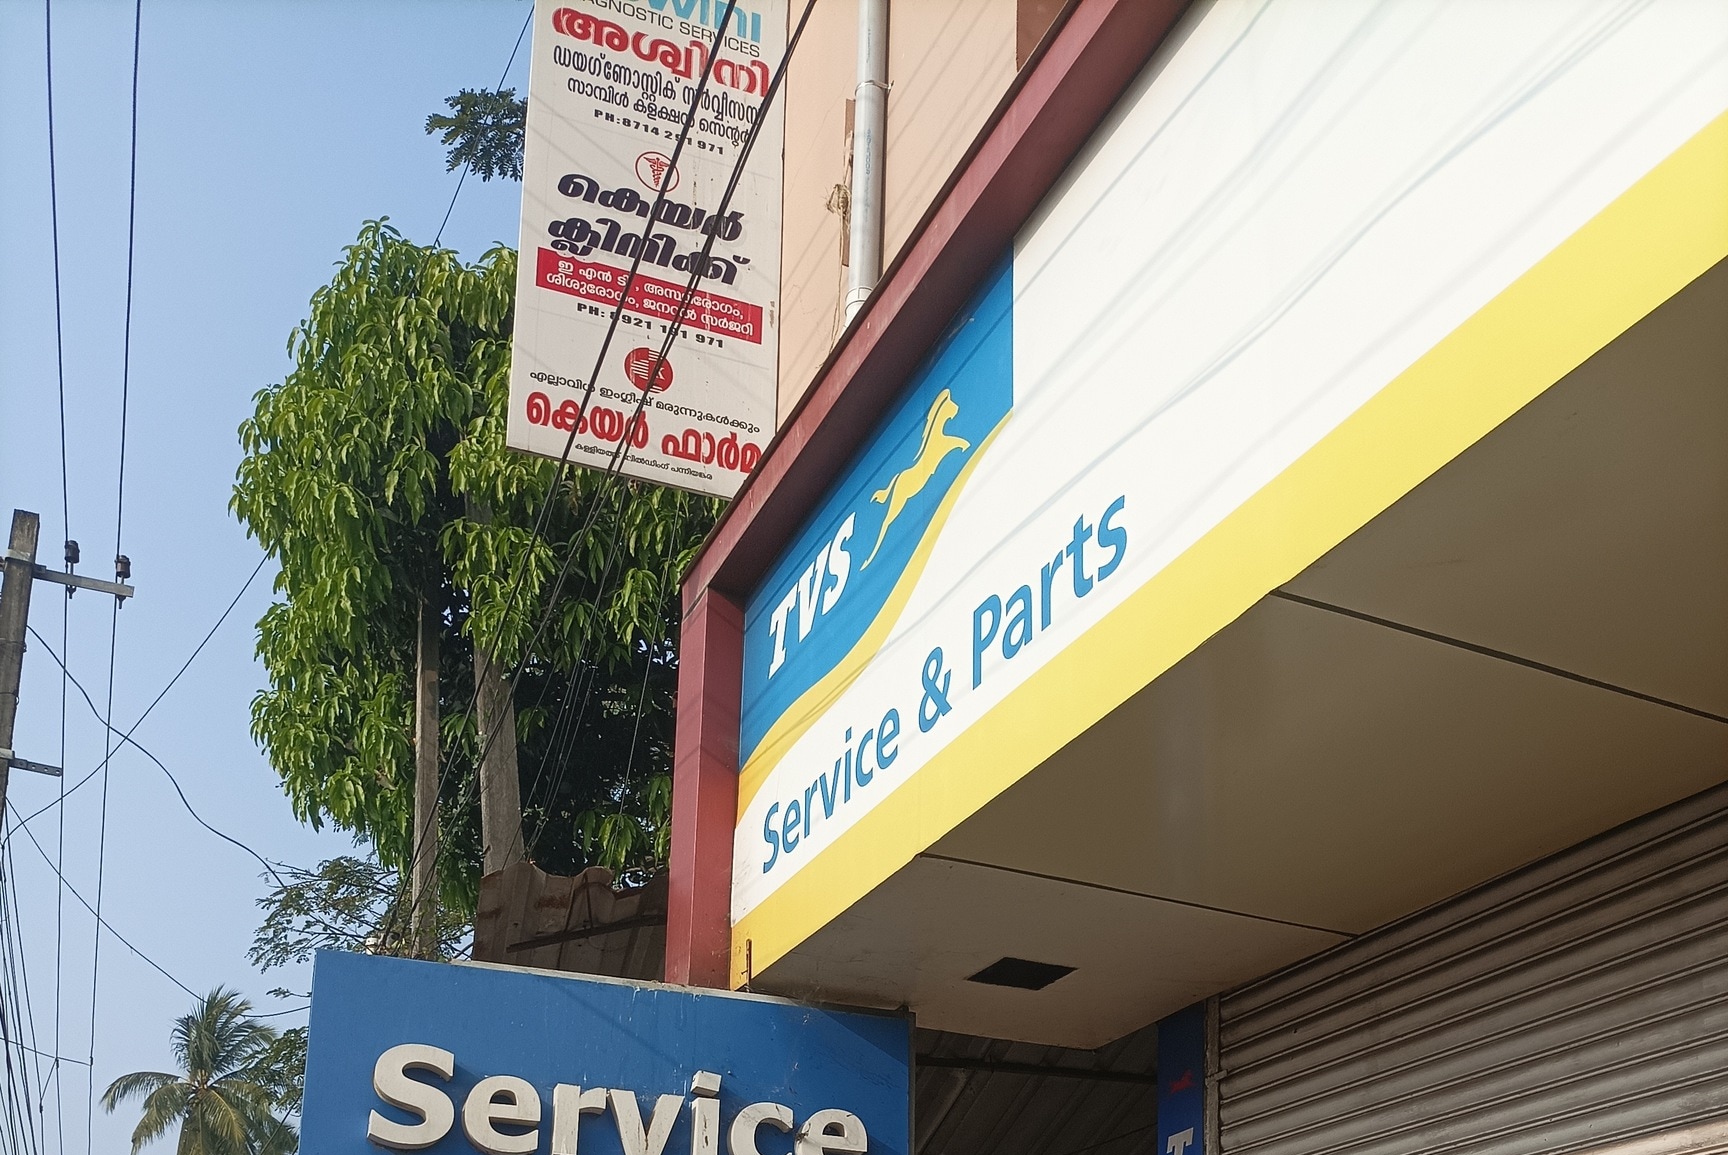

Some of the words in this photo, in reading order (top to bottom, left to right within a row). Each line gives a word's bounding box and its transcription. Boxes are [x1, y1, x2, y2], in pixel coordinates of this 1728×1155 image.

[551, 7, 770, 98] അശ്വിനി
[679, 21, 760, 58] SERVICES
[567, 77, 629, 109] സാമ്പിൾ
[697, 140, 724, 155] 971
[557, 173, 745, 241] കെയർ
[548, 217, 751, 285] ക്ലിനിക്ക്
[557, 260, 574, 275] ഇ
[578, 268, 612, 283] എൻ
[695, 333, 724, 348] 971
[526, 391, 649, 449] കെയർ
[767, 511, 856, 680] TVS
[763, 708, 900, 874] Service
[918, 646, 952, 733] &
[972, 494, 1128, 691] Parts
